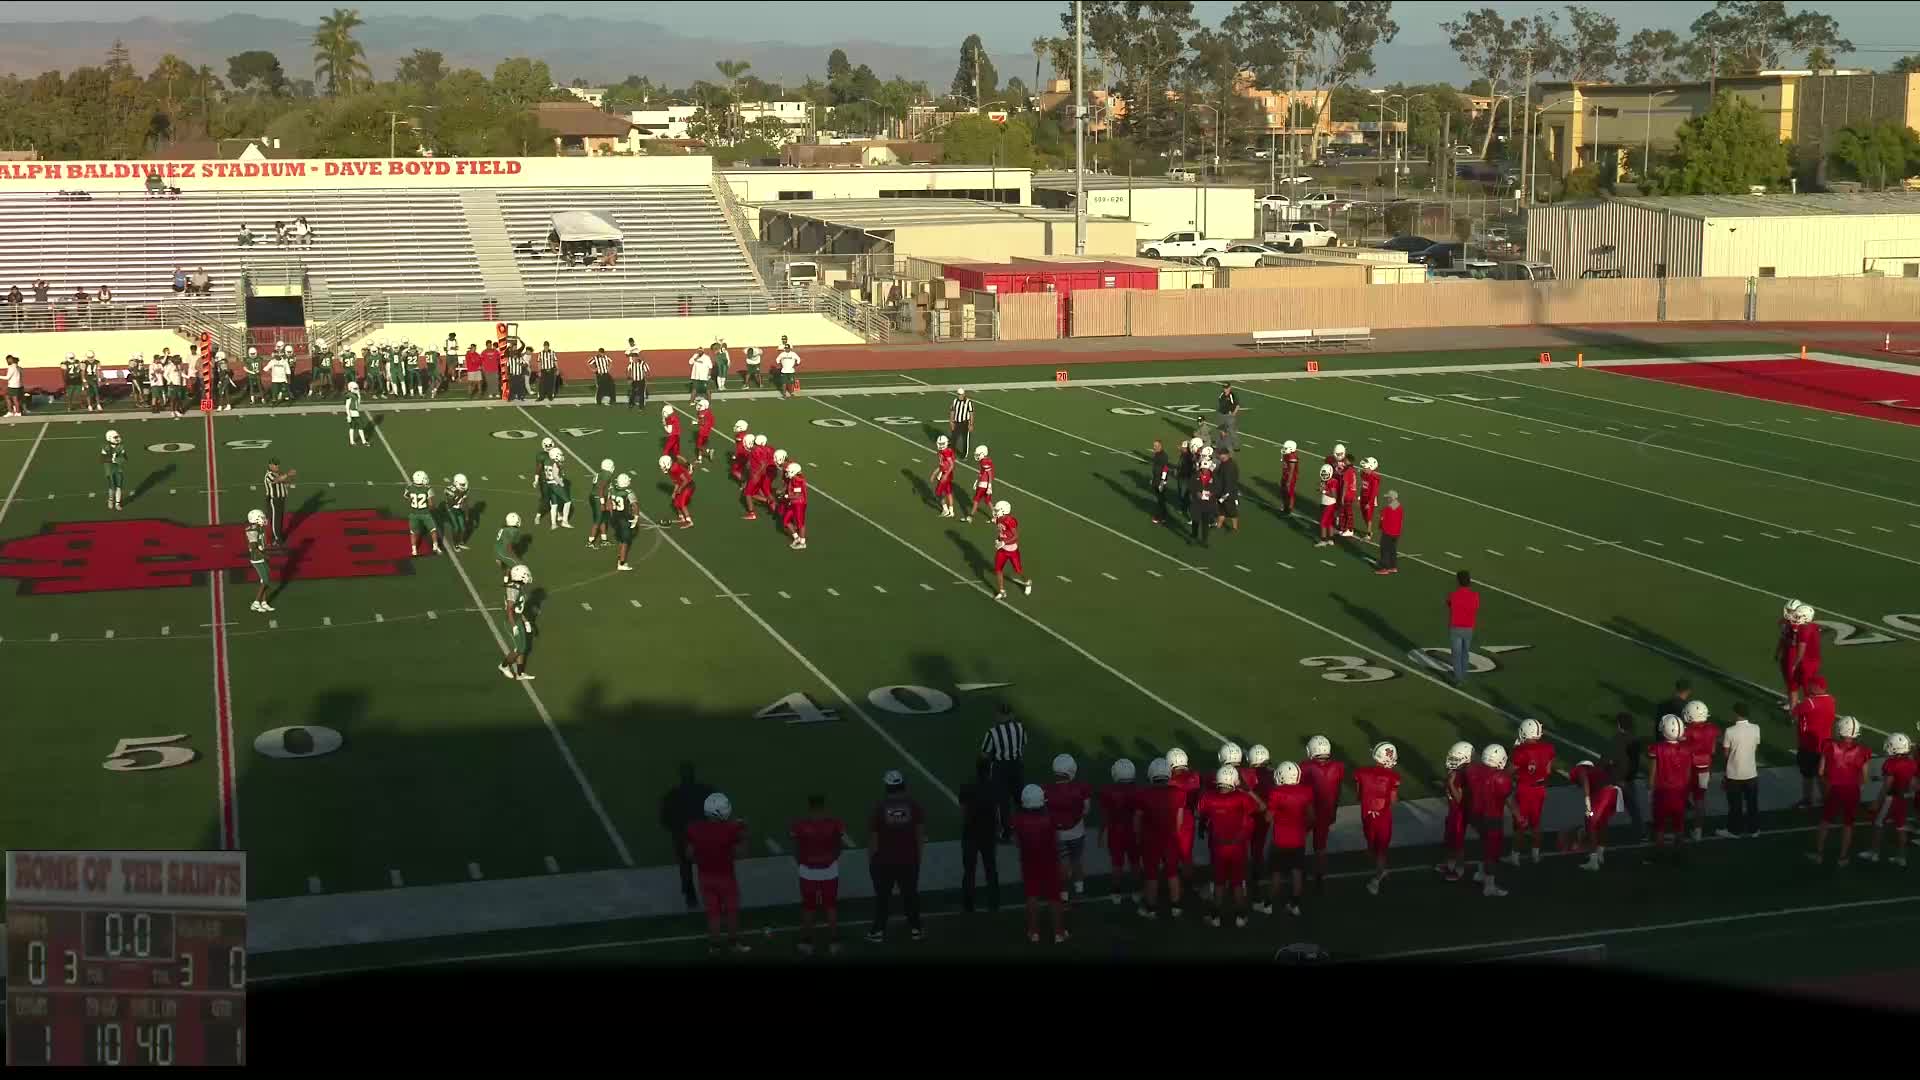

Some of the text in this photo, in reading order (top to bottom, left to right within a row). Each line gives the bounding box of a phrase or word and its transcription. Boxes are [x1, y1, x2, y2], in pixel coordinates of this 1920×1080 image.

[0, 164, 61, 179] ALPH
[67, 163, 196, 179] BALDIVIEZ
[202, 162, 305, 178] STADIUM
[325, 162, 382, 176] DAVE
[388, 161, 450, 175] BOYD
[456, 160, 522, 175] FIELD
[409, 493, 428, 509] 32
